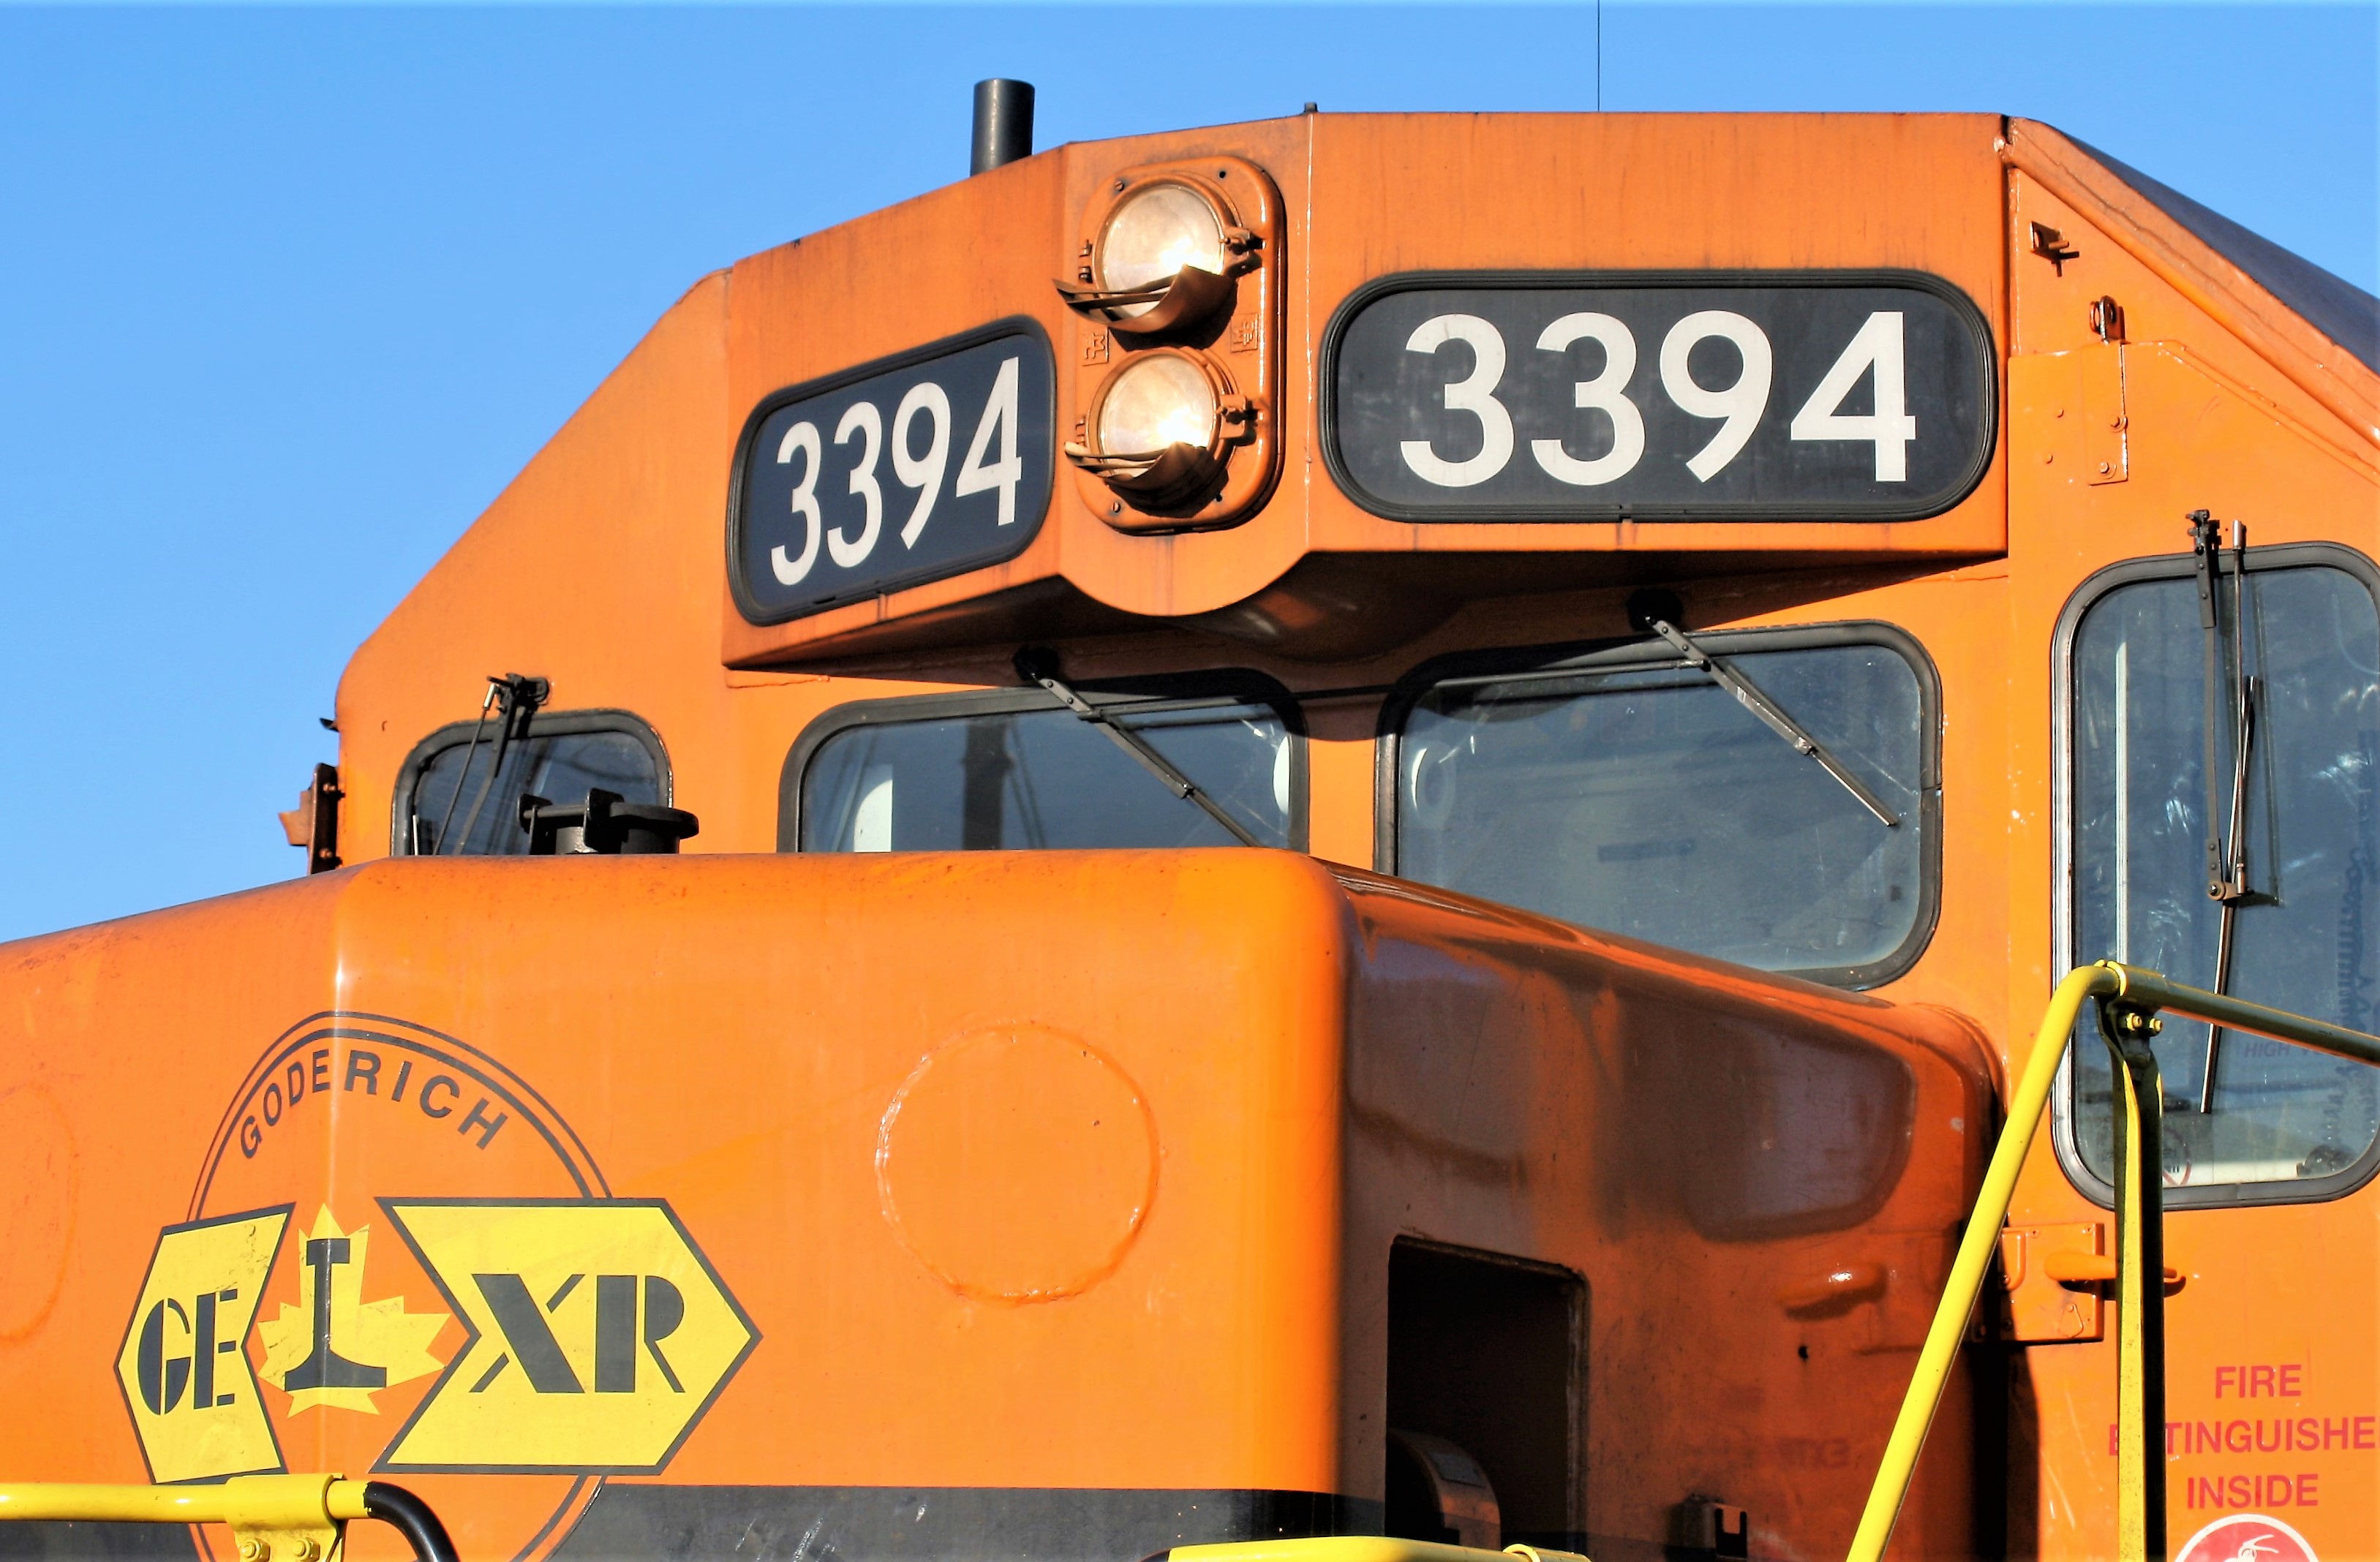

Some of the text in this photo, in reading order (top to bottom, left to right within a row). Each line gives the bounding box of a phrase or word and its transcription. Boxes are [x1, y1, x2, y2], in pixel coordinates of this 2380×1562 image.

[1399, 309, 1916, 488] 3394
[770, 356, 1023, 586] 3394
[239, 1049, 509, 1159] GODERICH
[2215, 1365, 2302, 1399] FIRE
[2109, 1416, 2380, 1457] TINGUISHE
[2187, 1474, 2319, 1509] INSIDE
